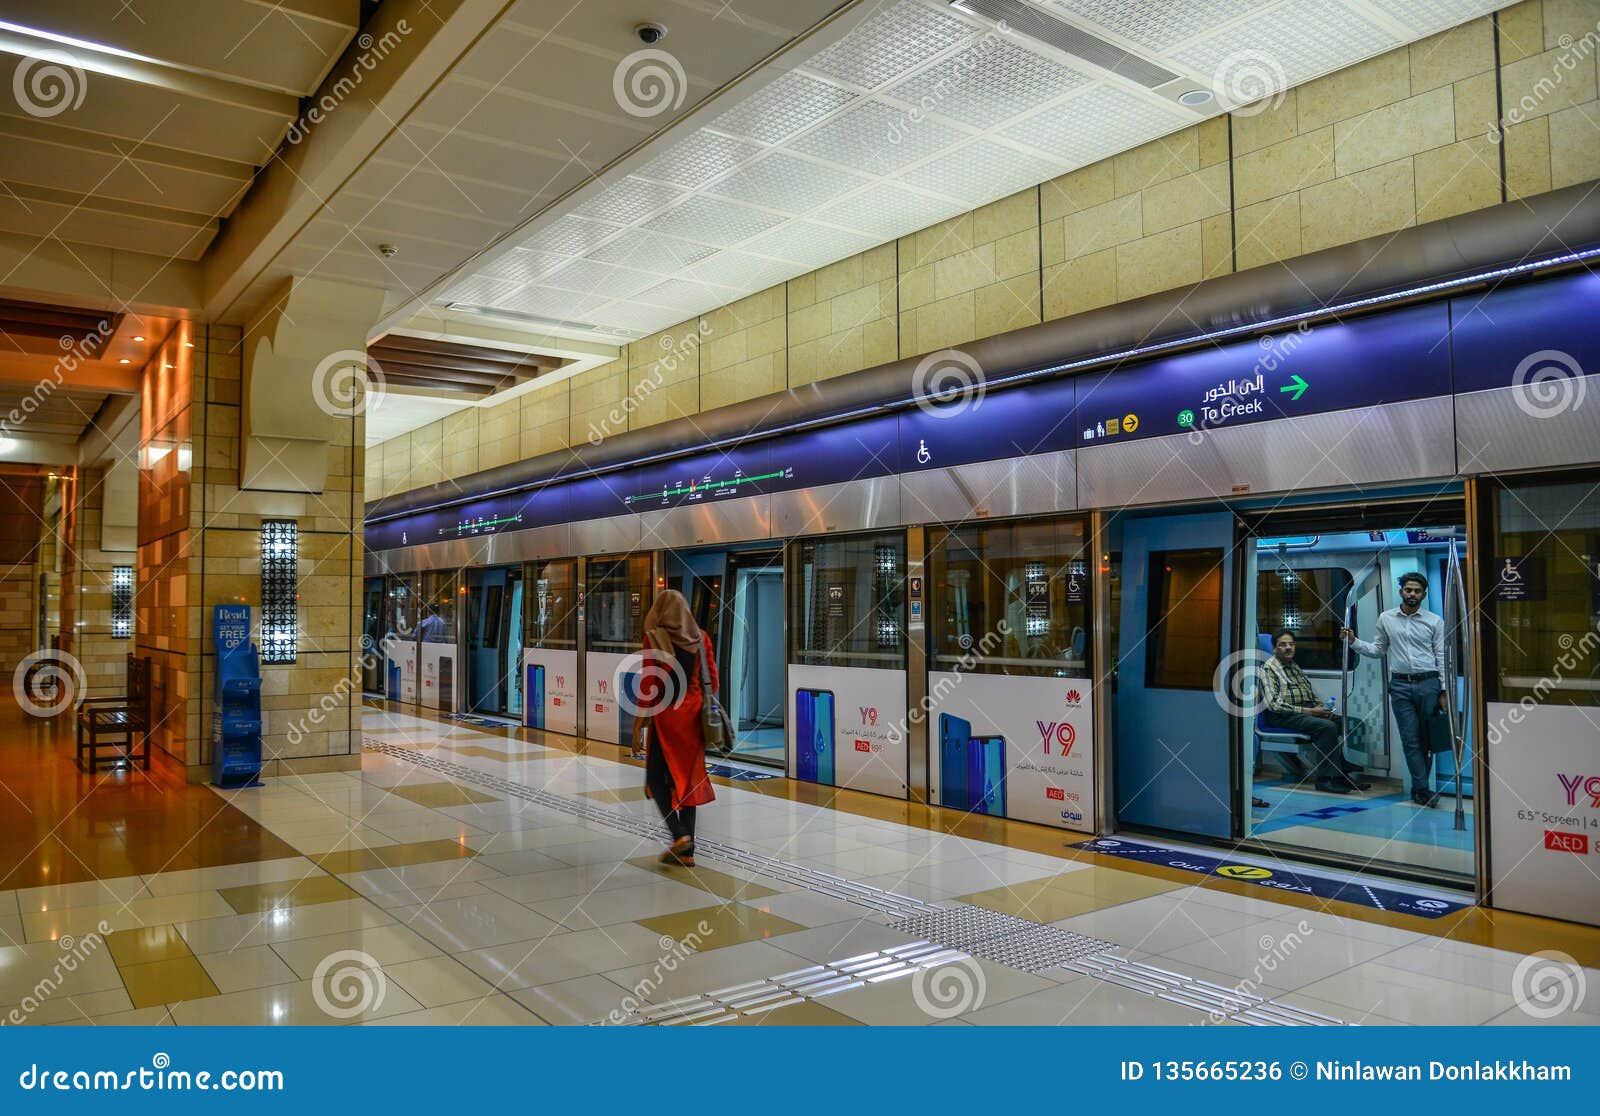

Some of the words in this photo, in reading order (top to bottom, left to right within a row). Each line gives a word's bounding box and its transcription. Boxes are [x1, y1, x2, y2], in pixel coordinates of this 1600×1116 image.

[1203, 379, 1236, 402] الخور
[1239, 375, 1264, 395] إلى
[1180, 413, 1193, 424] 30
[1201, 407, 1216, 420] To
[1221, 399, 1263, 417] Creek
[219, 630, 246, 639] FREE
[859, 707, 878, 726] Y9
[1037, 720, 1076, 757] Y9
[1049, 789, 1063, 799] AED
[1557, 773, 1600, 808] Y9
[1542, 812, 1580, 826] Screen
[1590, 818, 1598, 829] 4
[1551, 835, 1583, 850] AED
[1168, 861, 1208, 871] Out
